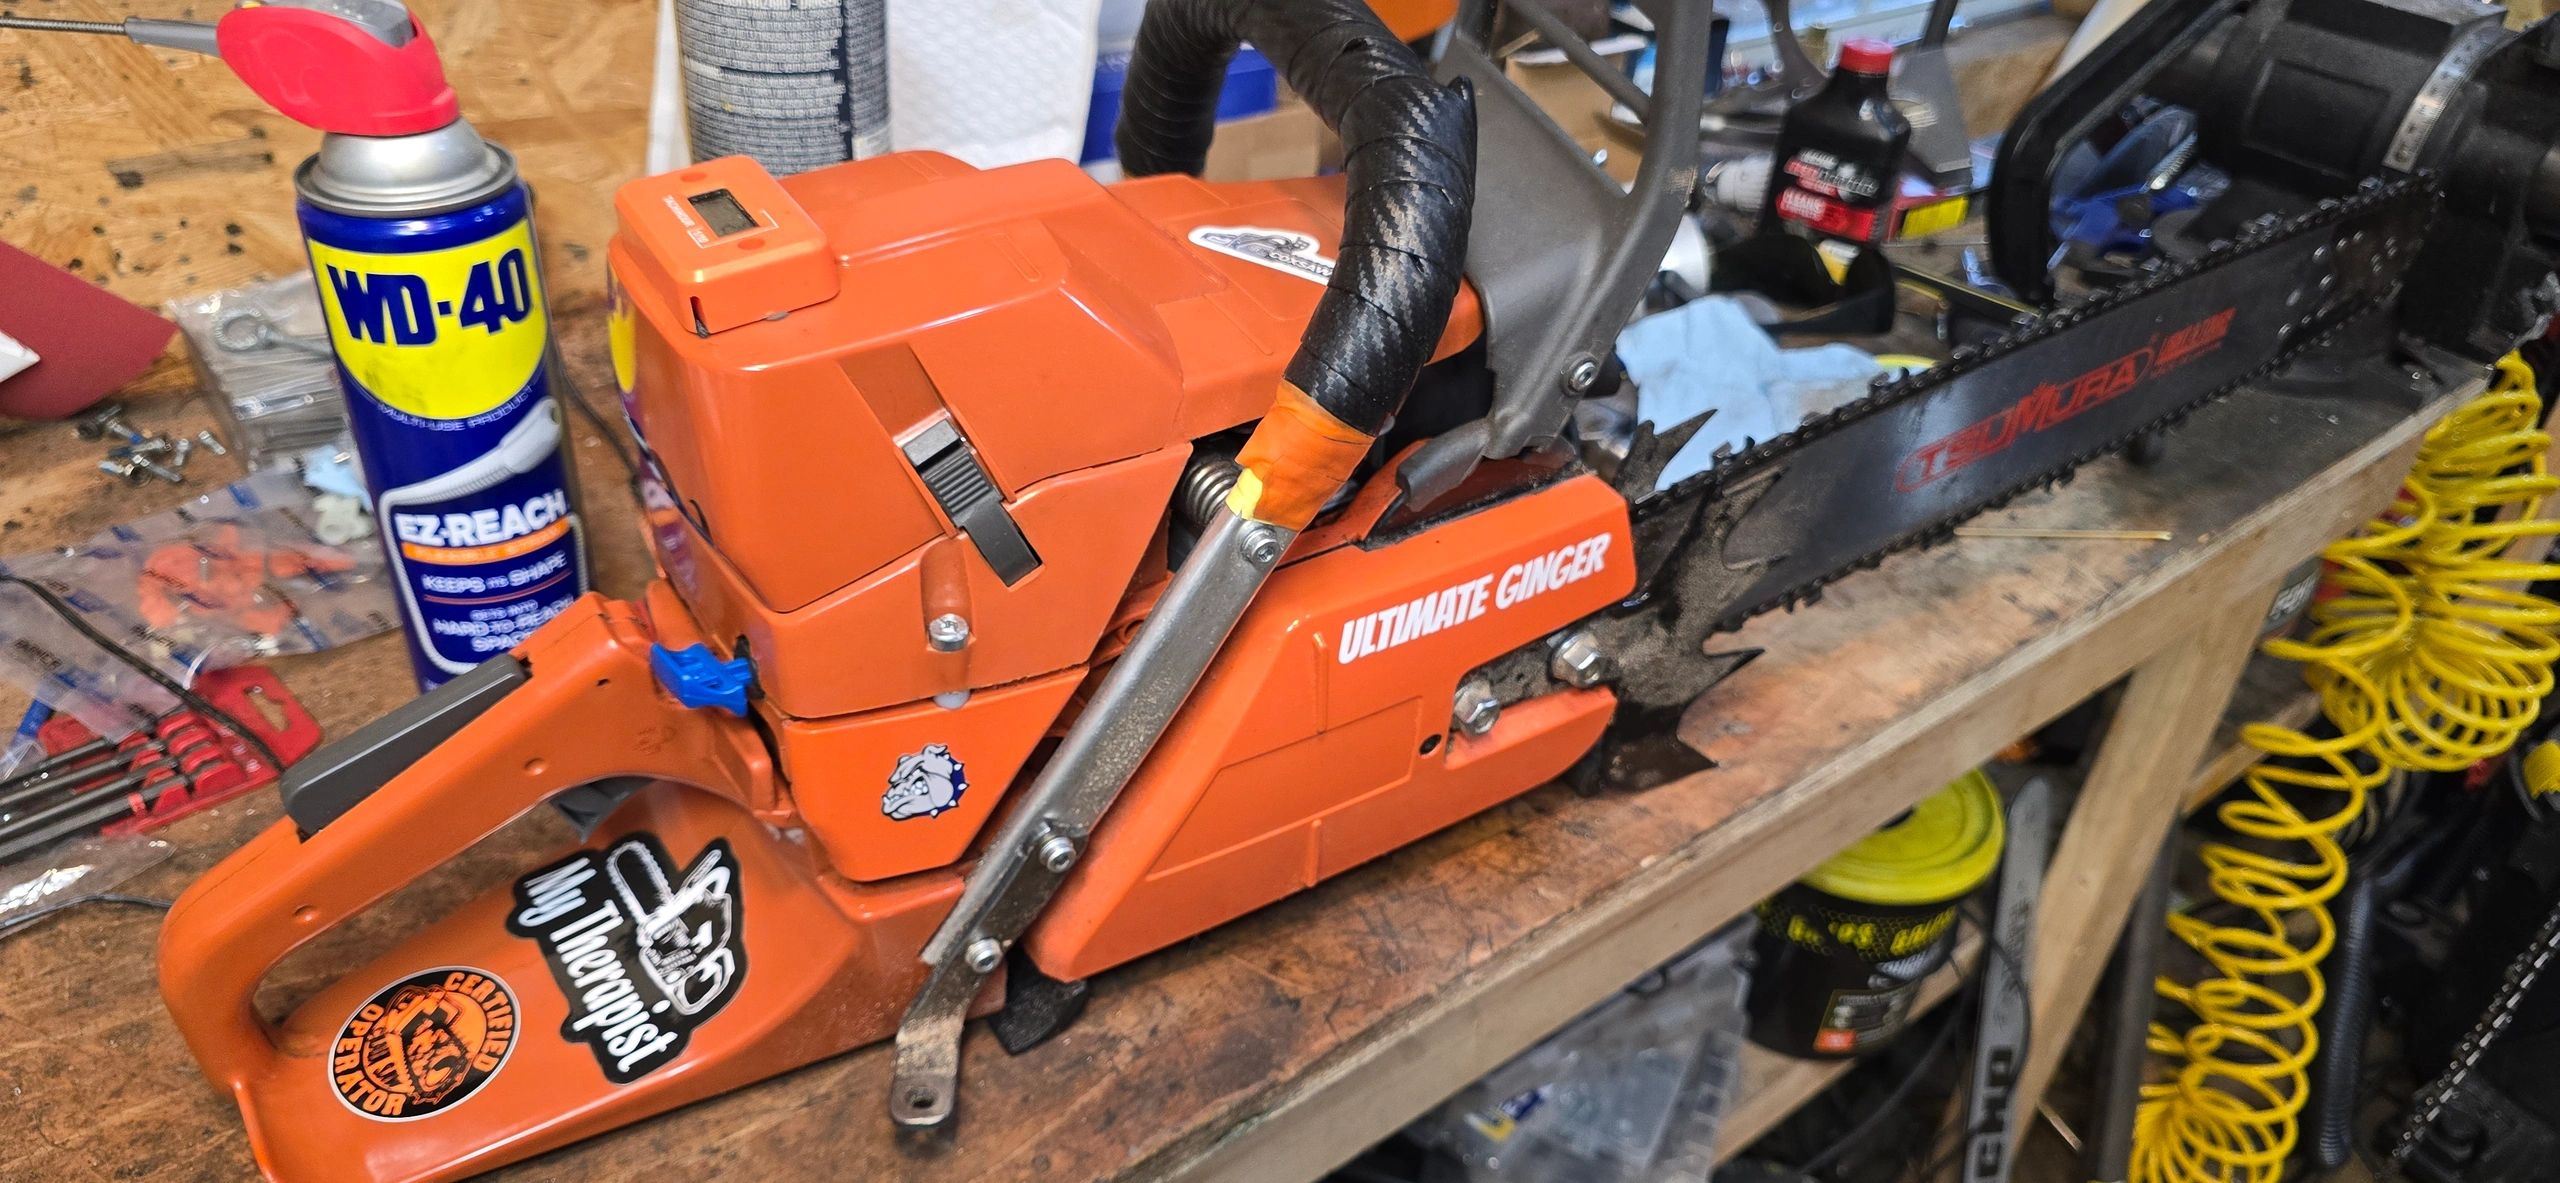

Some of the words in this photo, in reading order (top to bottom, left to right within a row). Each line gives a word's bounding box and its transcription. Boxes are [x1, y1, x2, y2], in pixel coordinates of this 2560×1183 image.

[326, 248, 531, 346] WD-40
[1914, 353, 2139, 481] TSUMURA
[394, 488, 568, 547] EZ-REACH
[421, 573, 487, 593] KEEPS
[508, 550, 568, 587] SHAPE
[1338, 573, 1494, 664] ULTIMATE
[1494, 532, 1612, 610] GINGER
[470, 628, 536, 652] SPAC
[518, 857, 598, 927] My
[443, 971, 513, 1073] CERTIFIED
[548, 898, 679, 1073] Therapist
[333, 1003, 407, 1116] OPERATOR
